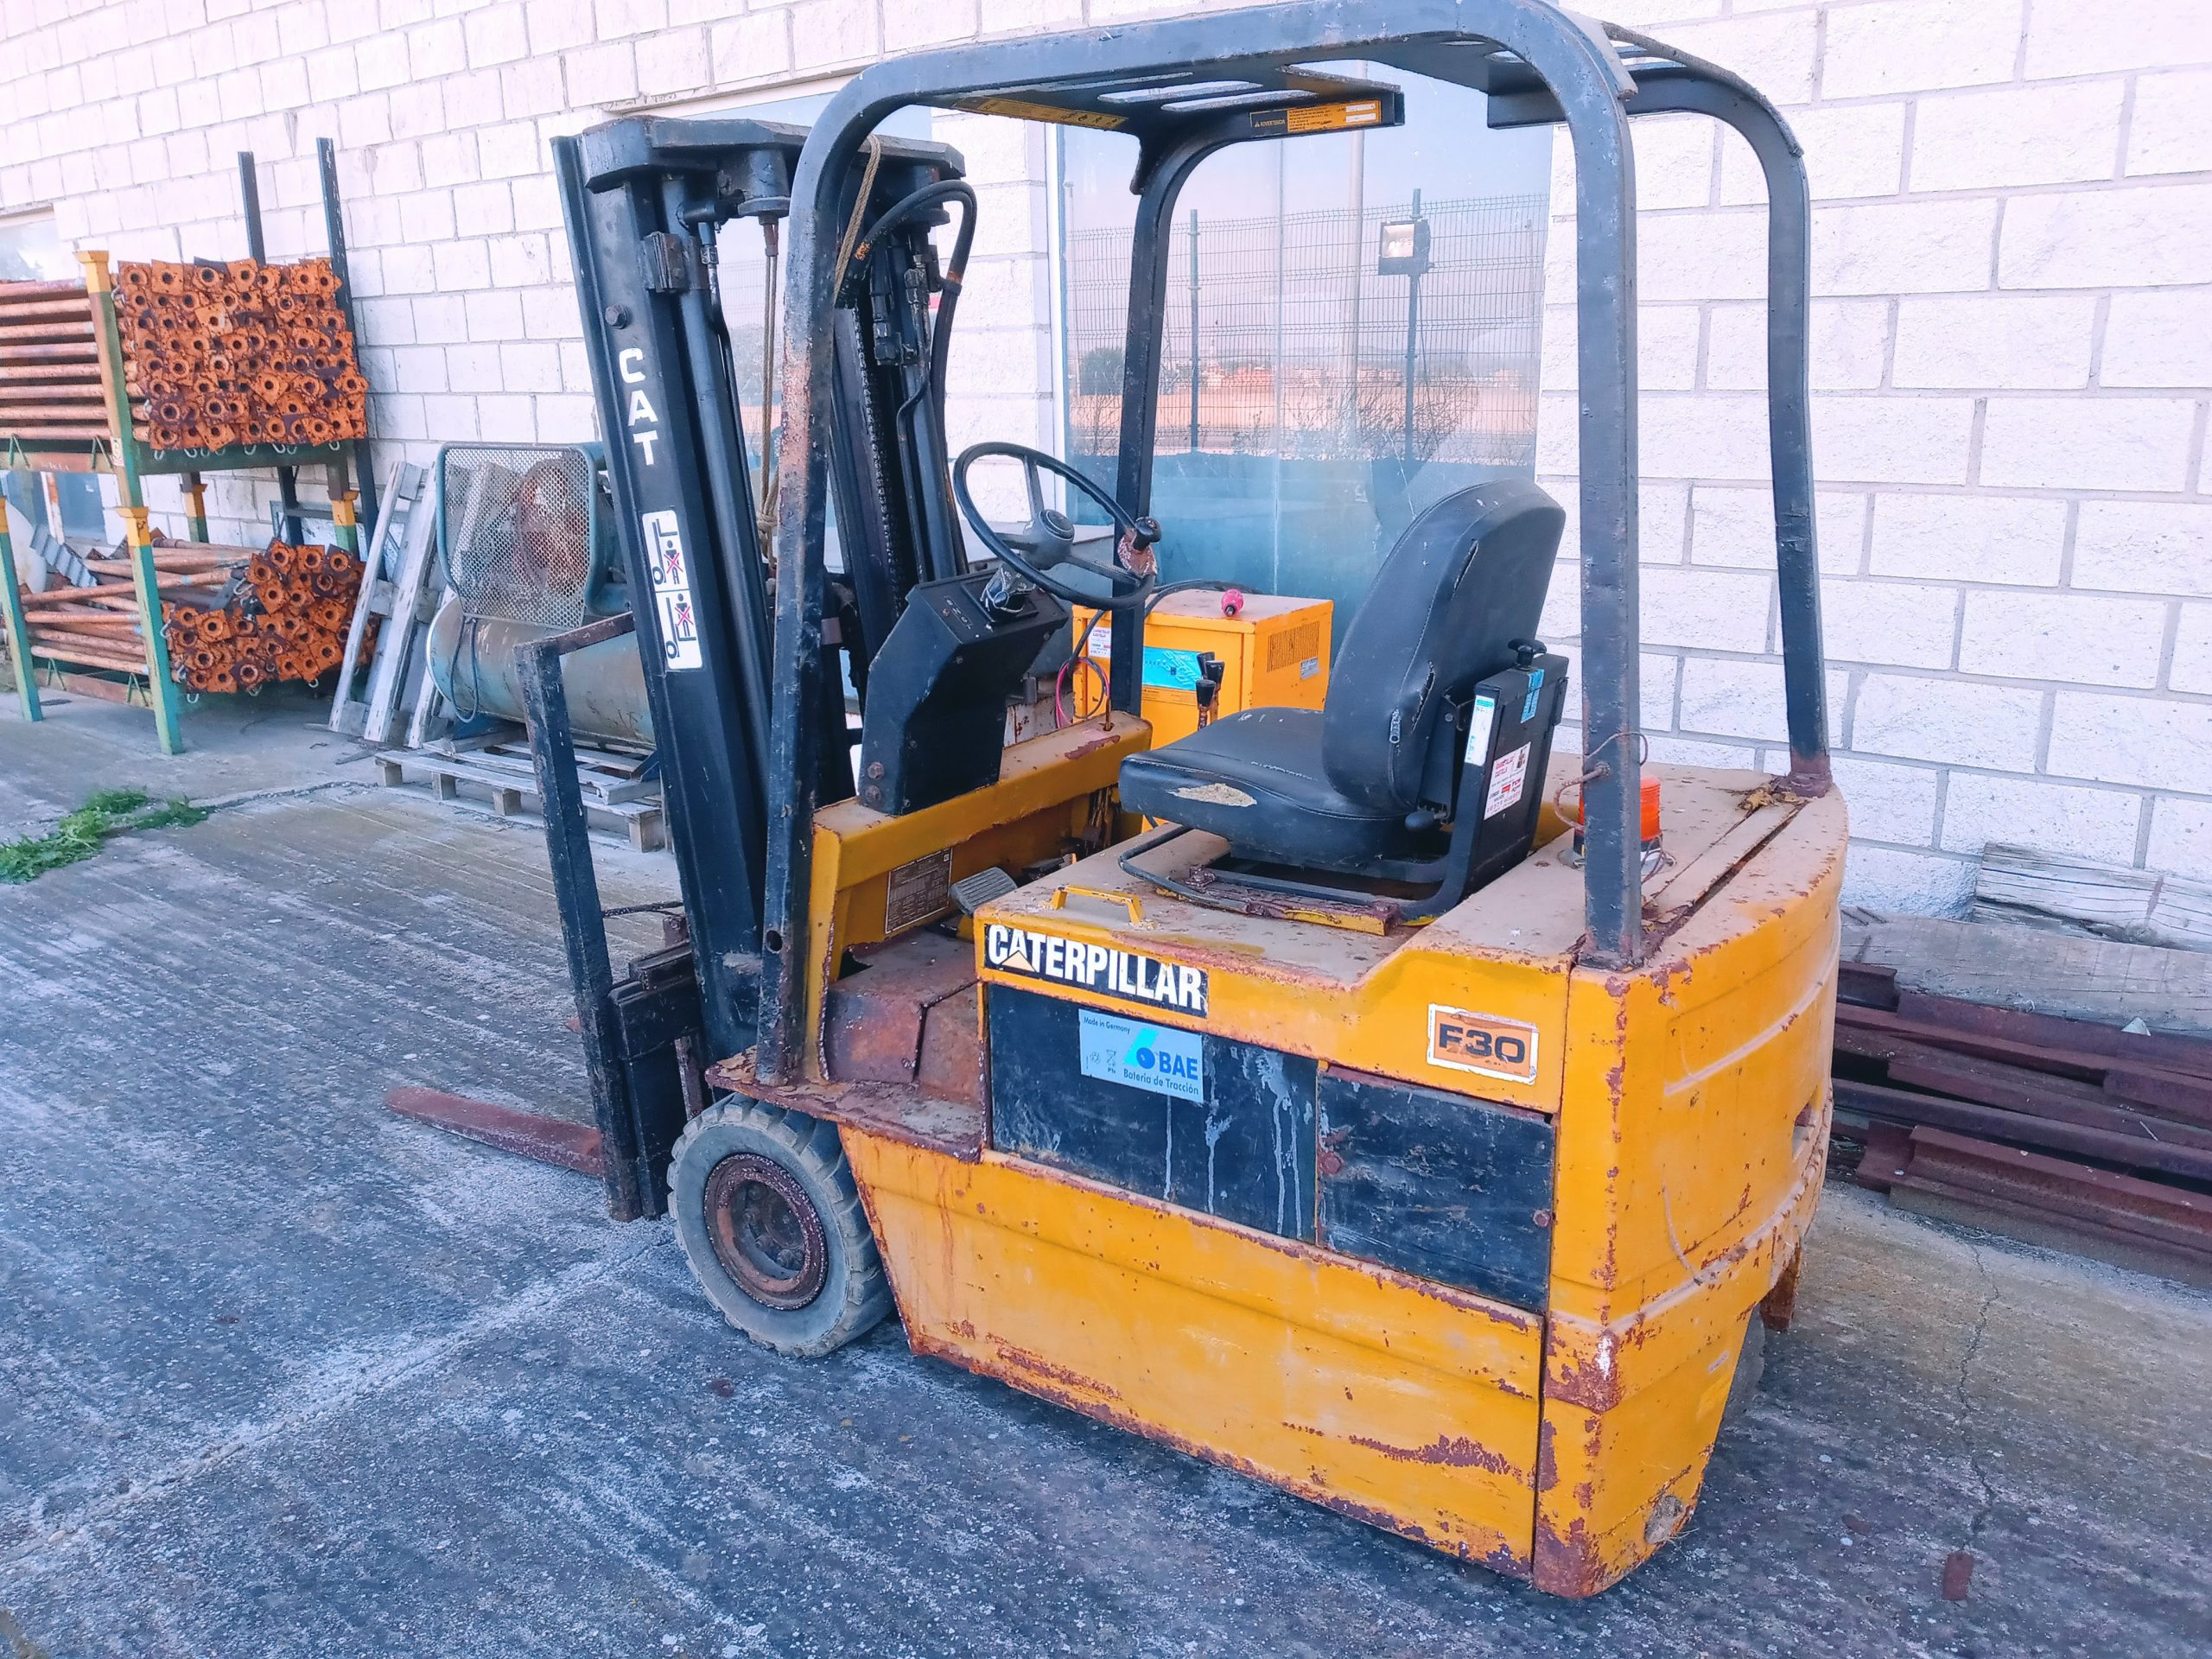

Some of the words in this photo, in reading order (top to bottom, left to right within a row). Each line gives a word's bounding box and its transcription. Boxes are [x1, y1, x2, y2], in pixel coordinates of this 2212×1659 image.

[619, 347, 659, 466] CAT
[988, 924, 1203, 1011] CATERPILLAR
[1084, 1016, 1098, 1027] Made
[1099, 1019, 1105, 1027] in
[1106, 1021, 1131, 1035] Germany
[1439, 1023, 1526, 1064] F30
[1159, 1051, 1198, 1080] BAE
[1154, 1076, 1164, 1087] de
[1166, 1077, 1198, 1096] Tracción
